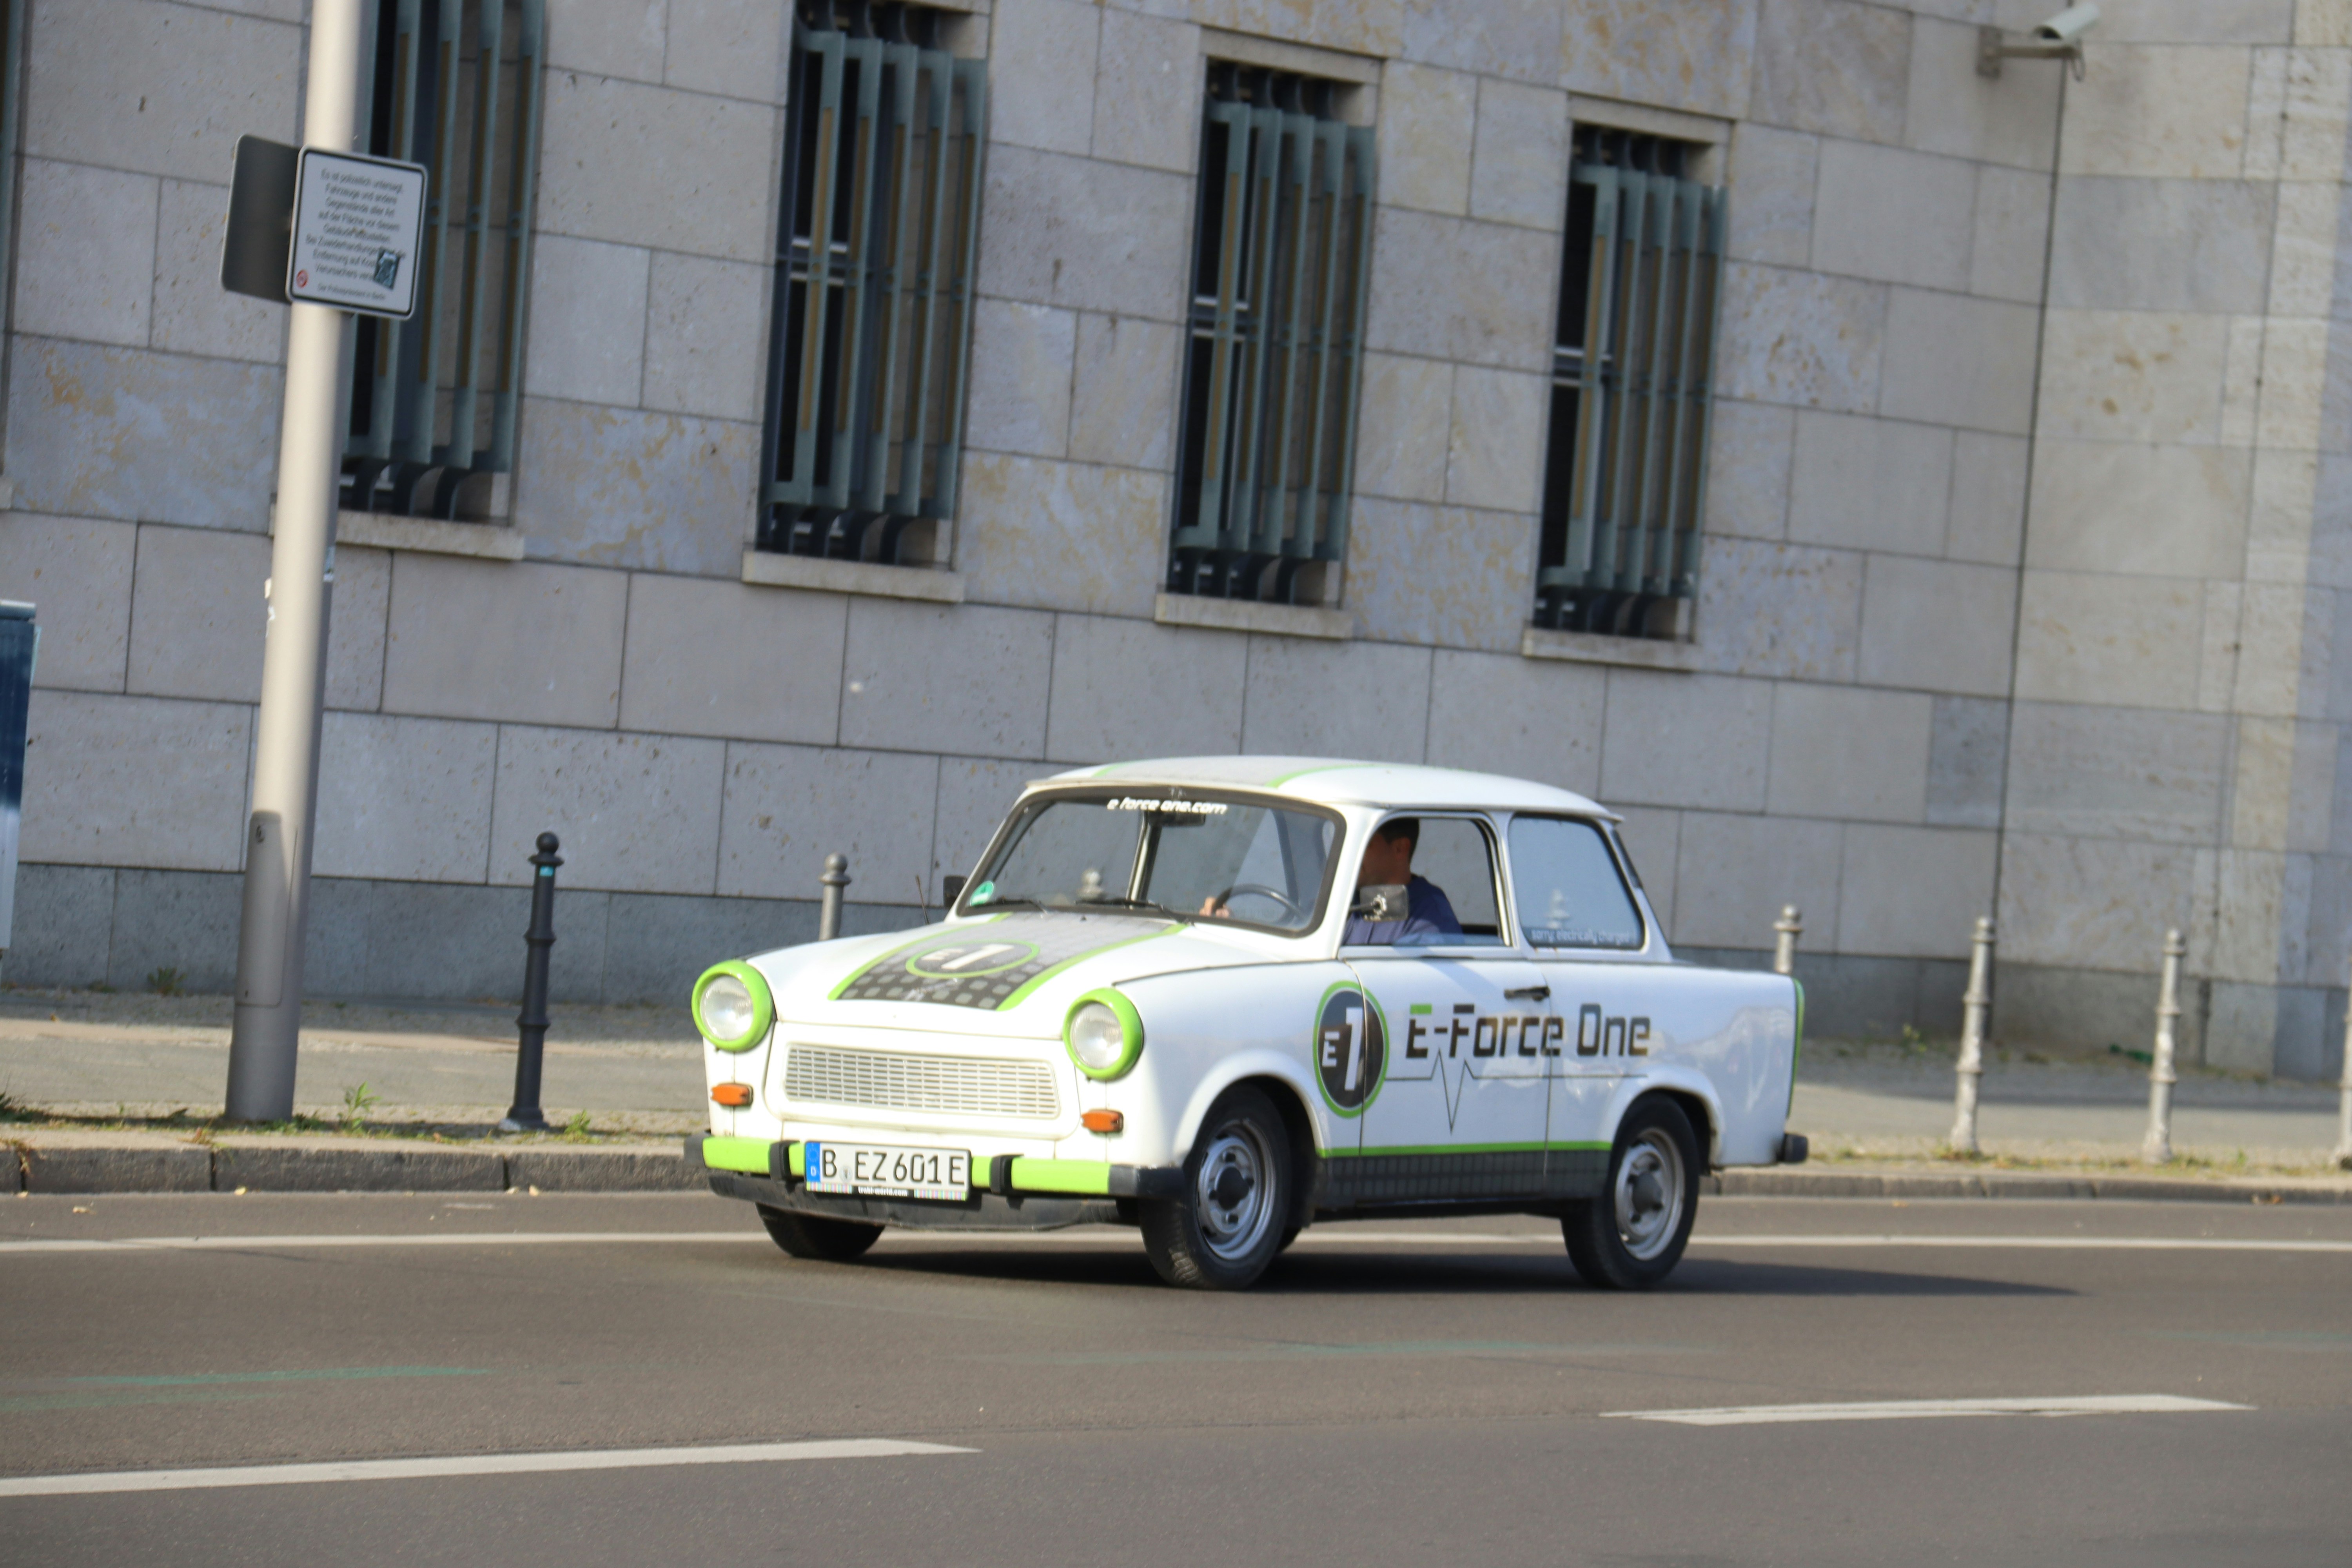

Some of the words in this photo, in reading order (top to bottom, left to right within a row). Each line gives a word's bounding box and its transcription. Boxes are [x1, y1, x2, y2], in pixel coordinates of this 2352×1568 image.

[320, 168, 330, 180] Es
[1405, 1003, 1564, 1059] E-Force
[1577, 1003, 1651, 1058] One
[823, 1149, 837, 1178] B
